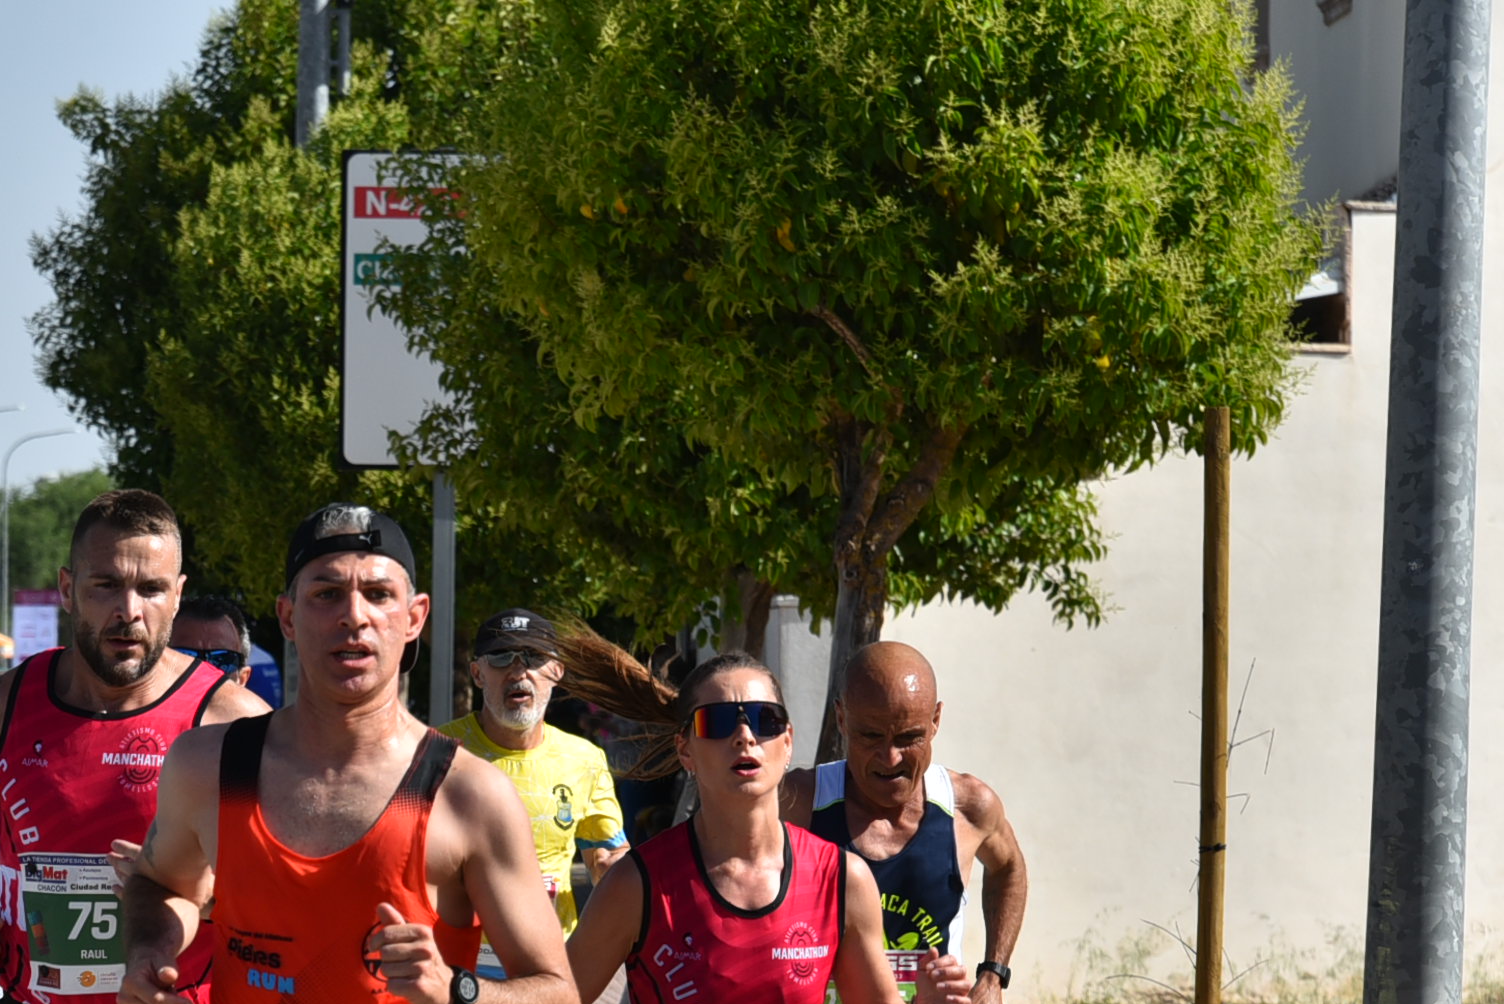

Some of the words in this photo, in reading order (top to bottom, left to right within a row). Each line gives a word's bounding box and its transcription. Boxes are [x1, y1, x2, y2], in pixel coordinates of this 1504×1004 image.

[101, 752, 165, 767] MANCHATH
[67, 901, 118, 940] 75
[880, 893, 910, 916] ACA
[911, 907, 944, 948] TRAIL
[80, 949, 108, 959] RAUL
[772, 945, 830, 960] MANCHATHON
[247, 967, 295, 994] RUN
